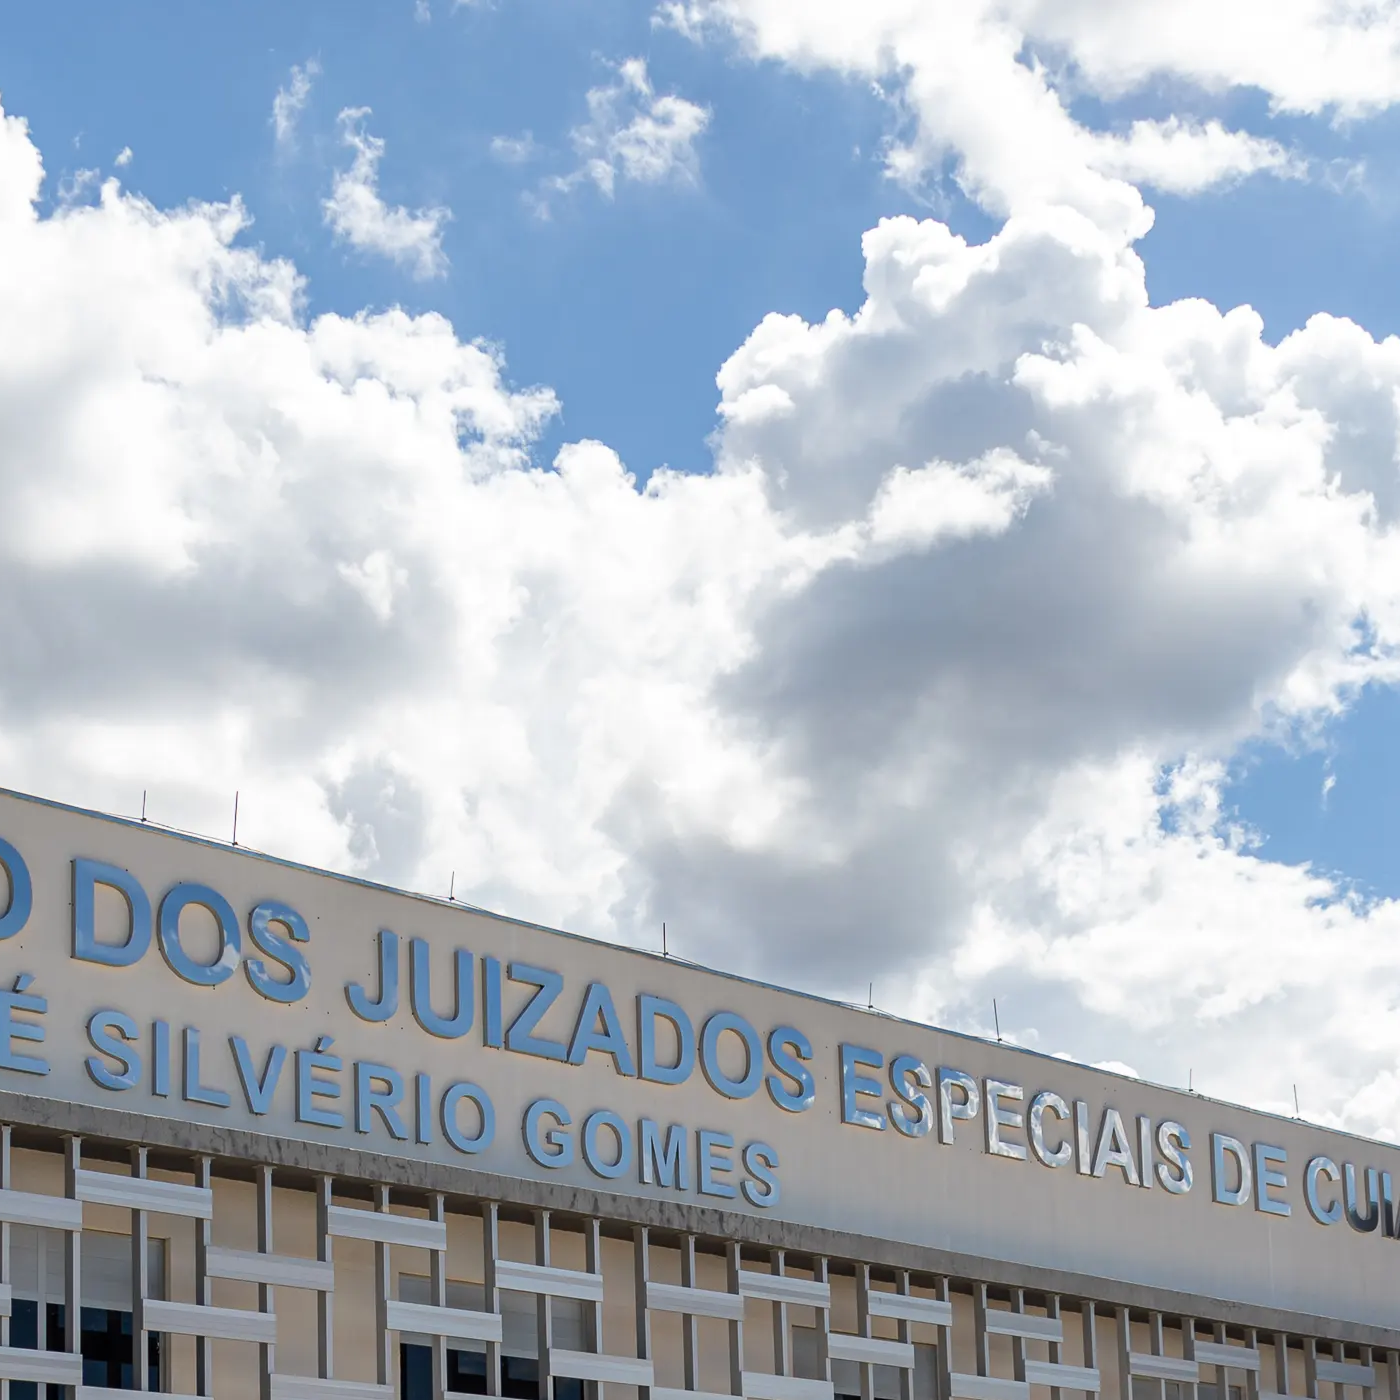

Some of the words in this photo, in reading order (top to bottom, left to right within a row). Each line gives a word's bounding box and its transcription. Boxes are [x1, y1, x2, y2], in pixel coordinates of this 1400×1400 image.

[70, 858, 311, 1004] DOS
[344, 930, 816, 1113] JUIZADOS
[838, 1042, 1194, 1196] ESPECIAIS
[1209, 1131, 1292, 1218] DE
[84, 1009, 497, 1155] SILVÉRIO
[521, 1097, 782, 1209] GOMES
